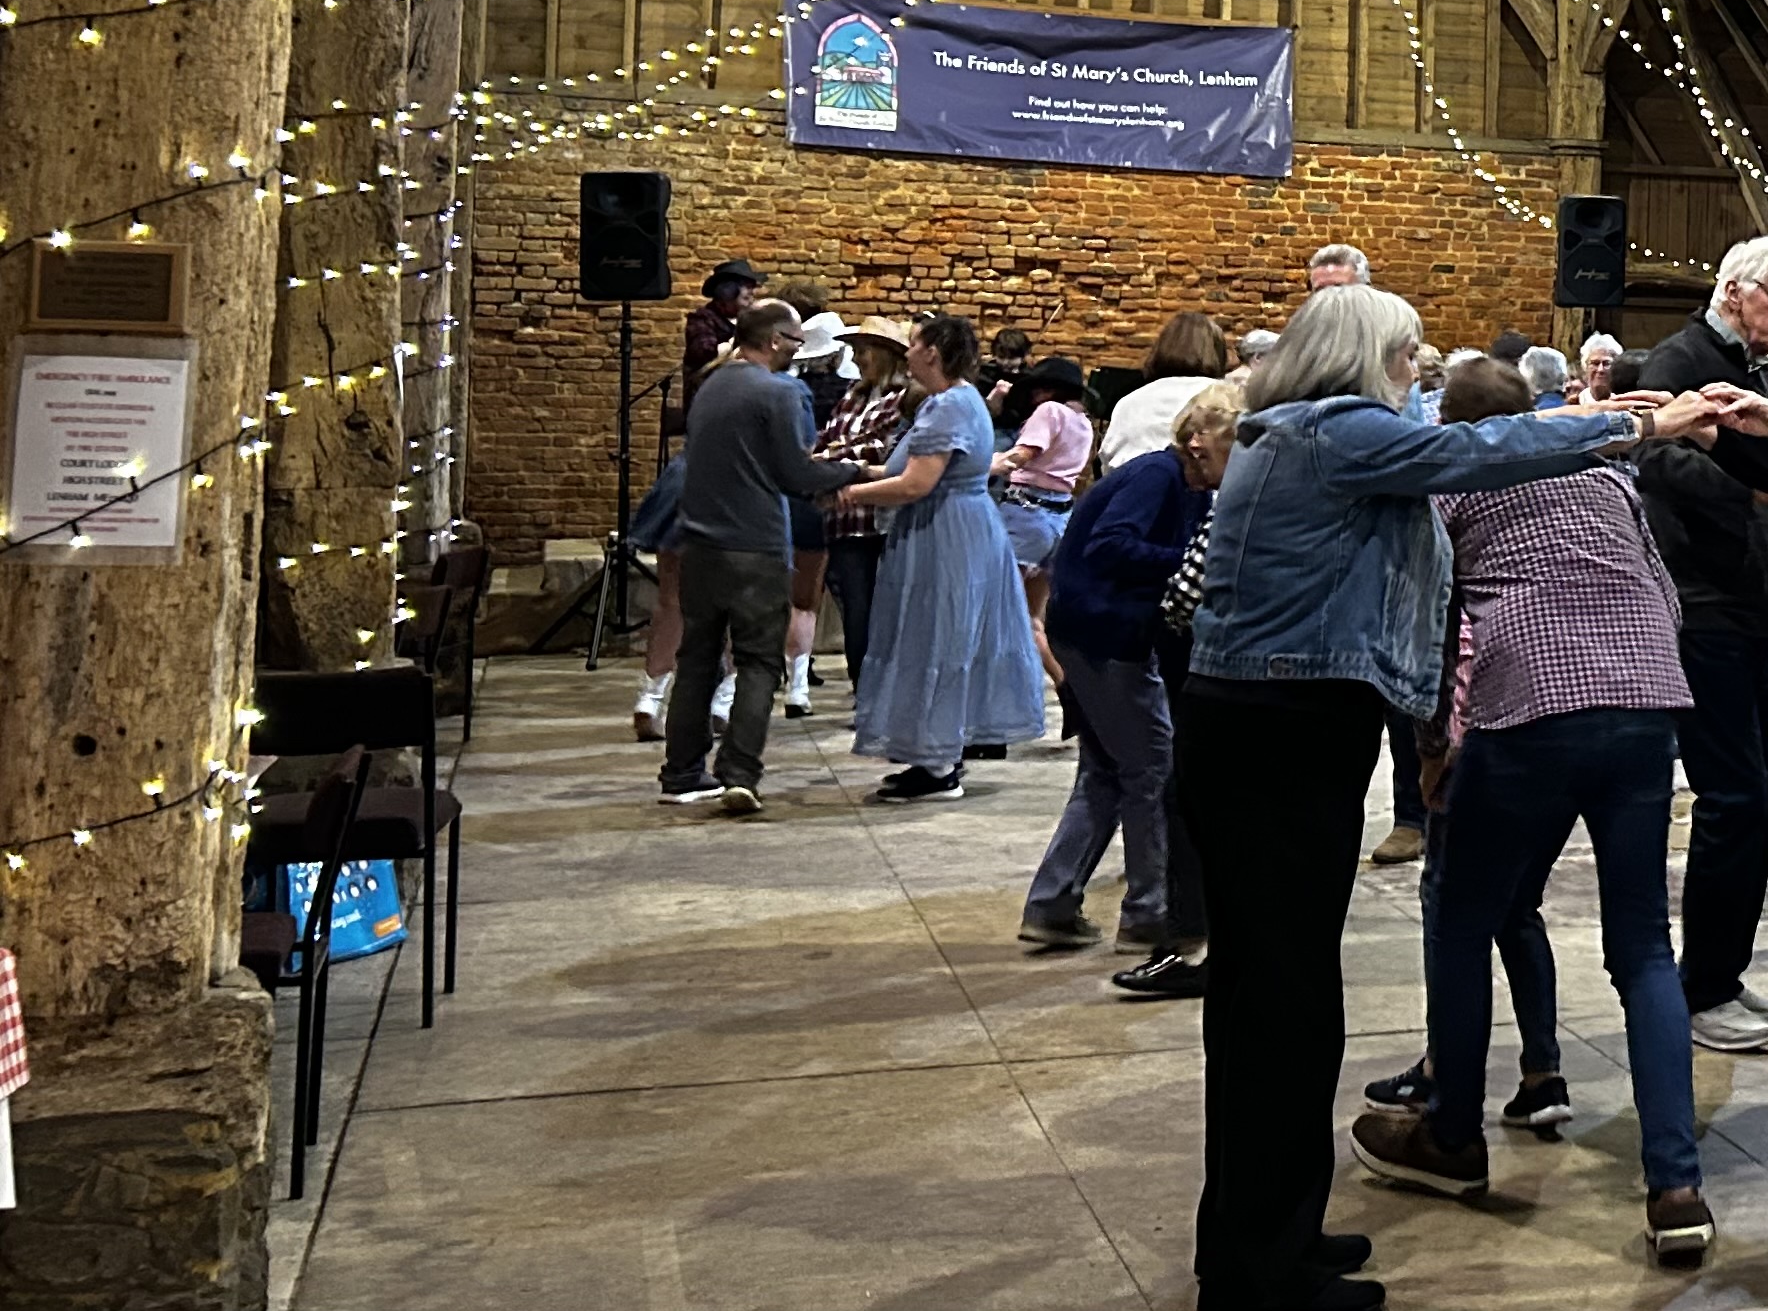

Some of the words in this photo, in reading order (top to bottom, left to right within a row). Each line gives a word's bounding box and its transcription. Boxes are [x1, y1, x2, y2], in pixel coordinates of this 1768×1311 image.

[933, 51, 962, 68] The
[967, 54, 1025, 75] Friends
[1029, 60, 1048, 76] of
[1050, 62, 1067, 78] St
[1072, 64, 1129, 84] Mary's
[1133, 67, 1194, 87] Church,
[1199, 70, 1258, 87] Lenham
[1028, 95, 1051, 108] Find
[1054, 98, 1071, 109] out
[1072, 98, 1096, 110] how
[1098, 102, 1118, 114] you
[1120, 104, 1140, 113] can
[1142, 102, 1169, 116] help:
